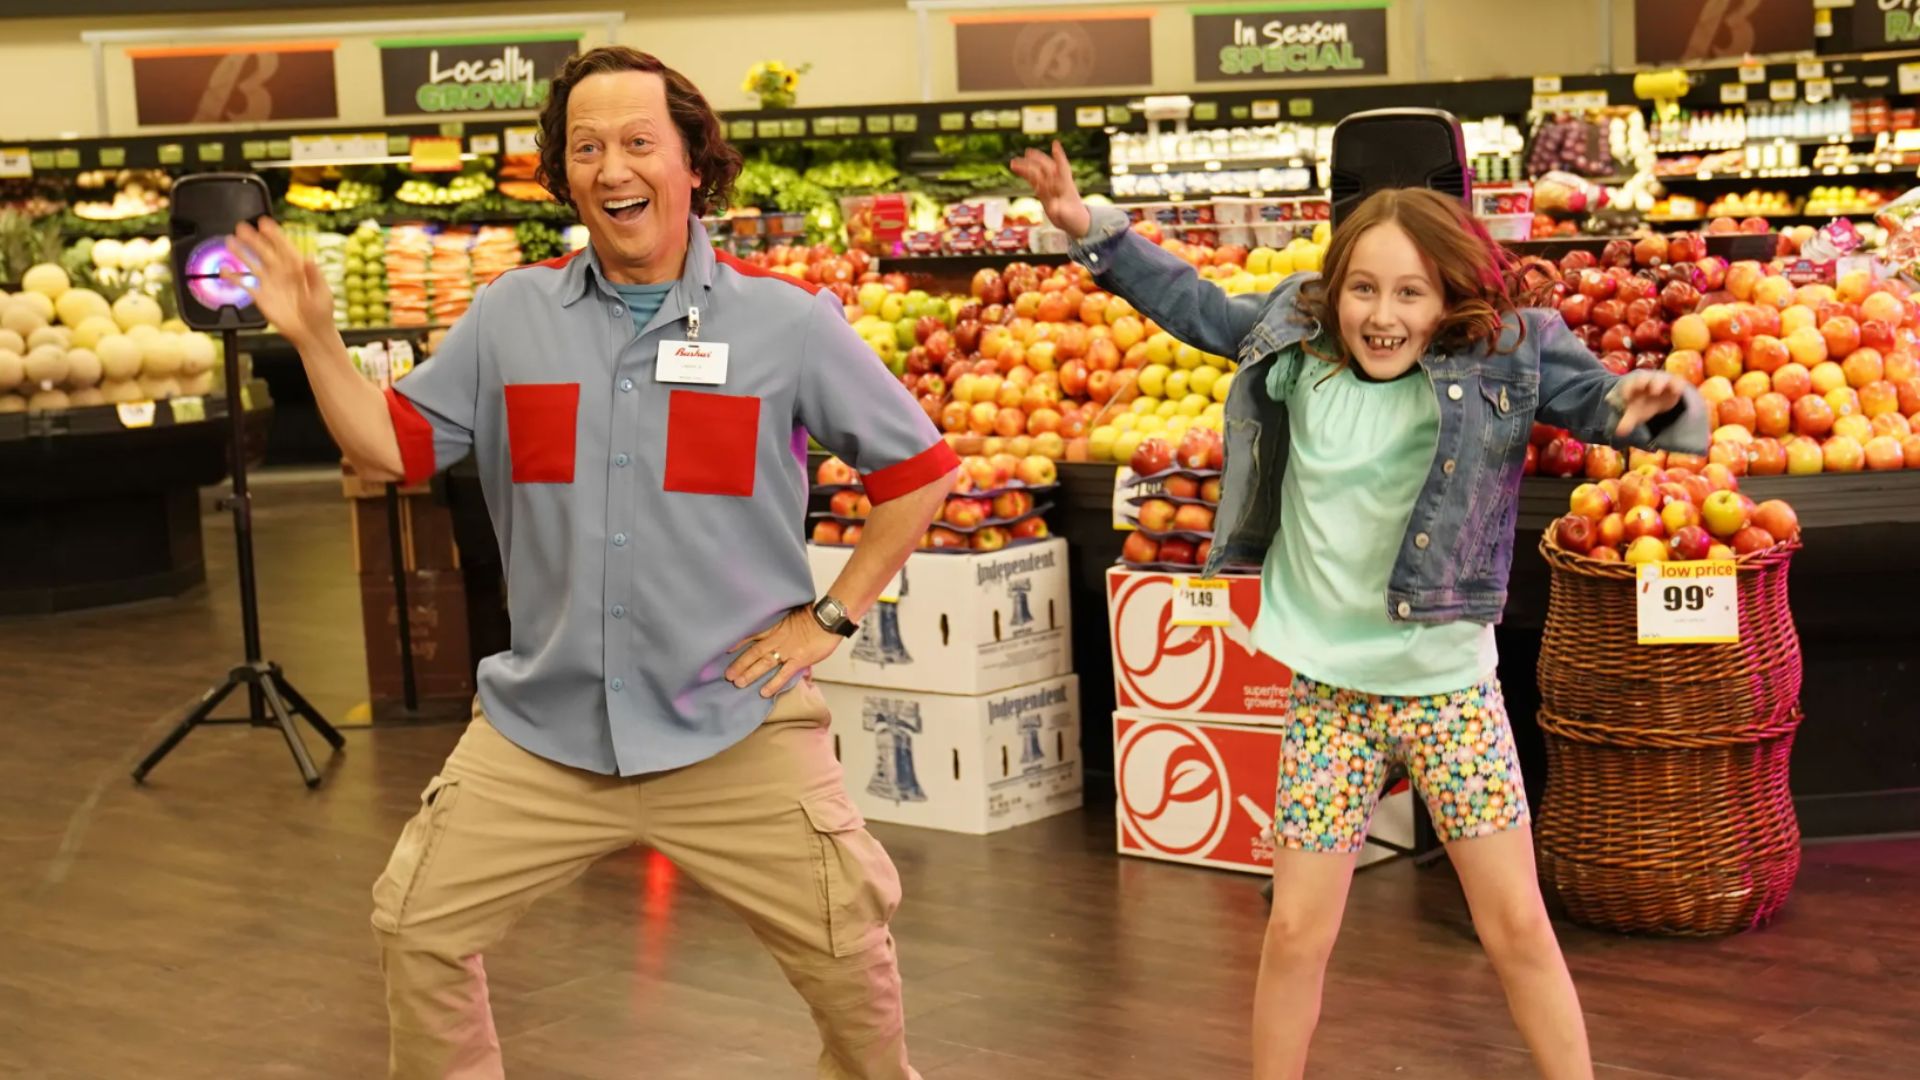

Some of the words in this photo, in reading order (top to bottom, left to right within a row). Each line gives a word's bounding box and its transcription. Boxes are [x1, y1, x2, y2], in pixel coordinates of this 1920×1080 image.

[1234, 18, 1257, 46] In
[1262, 20, 1348, 49] Season
[430, 46, 534, 98] Locally
[1219, 41, 1364, 74] SPECIAL
[416, 79, 550, 112] GROWN
[977, 549, 1055, 586] Independent
[1661, 565, 1691, 578] low
[1695, 562, 1733, 578] price
[988, 684, 1067, 725] Independent
